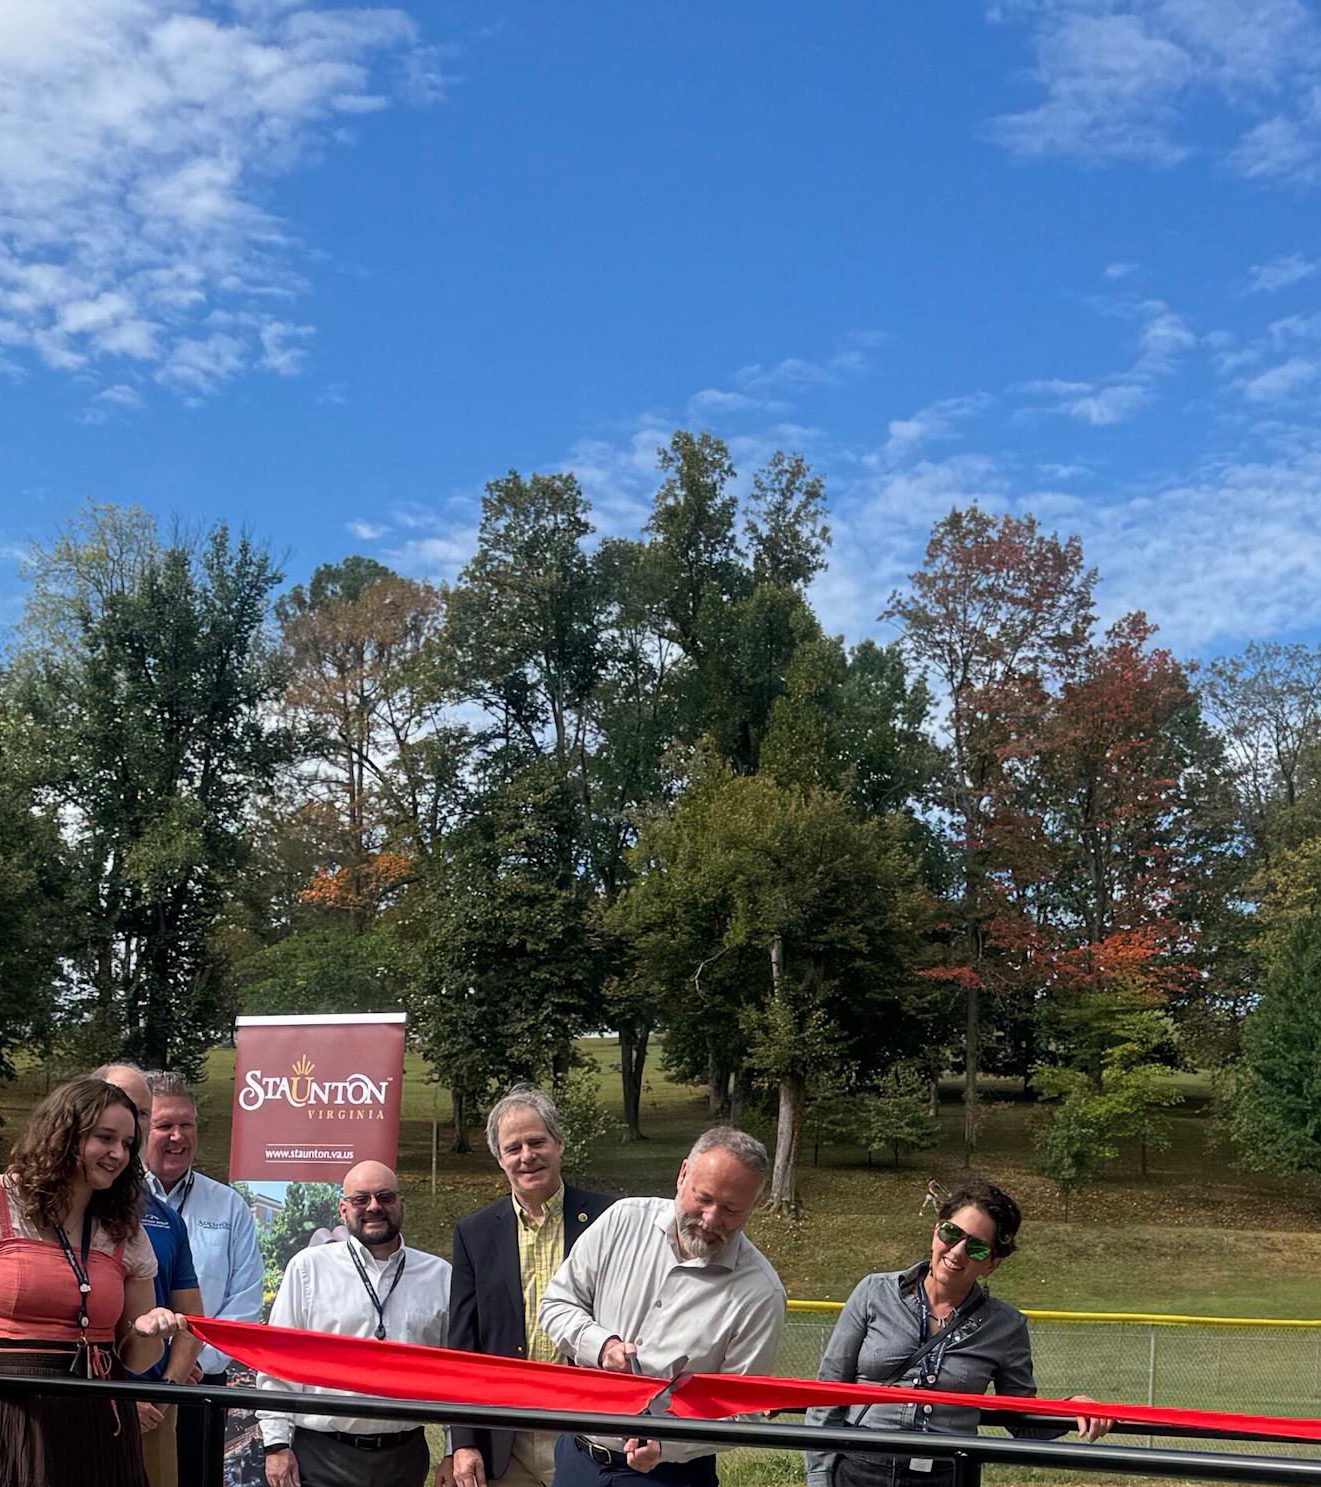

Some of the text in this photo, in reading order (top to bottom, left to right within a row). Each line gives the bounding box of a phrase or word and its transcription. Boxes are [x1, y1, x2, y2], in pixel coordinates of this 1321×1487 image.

[239, 1069, 389, 1111] STAUNTON
[307, 1109, 385, 1120] VIRGINIA
[265, 1148, 354, 1160] www.staunton.va.us
